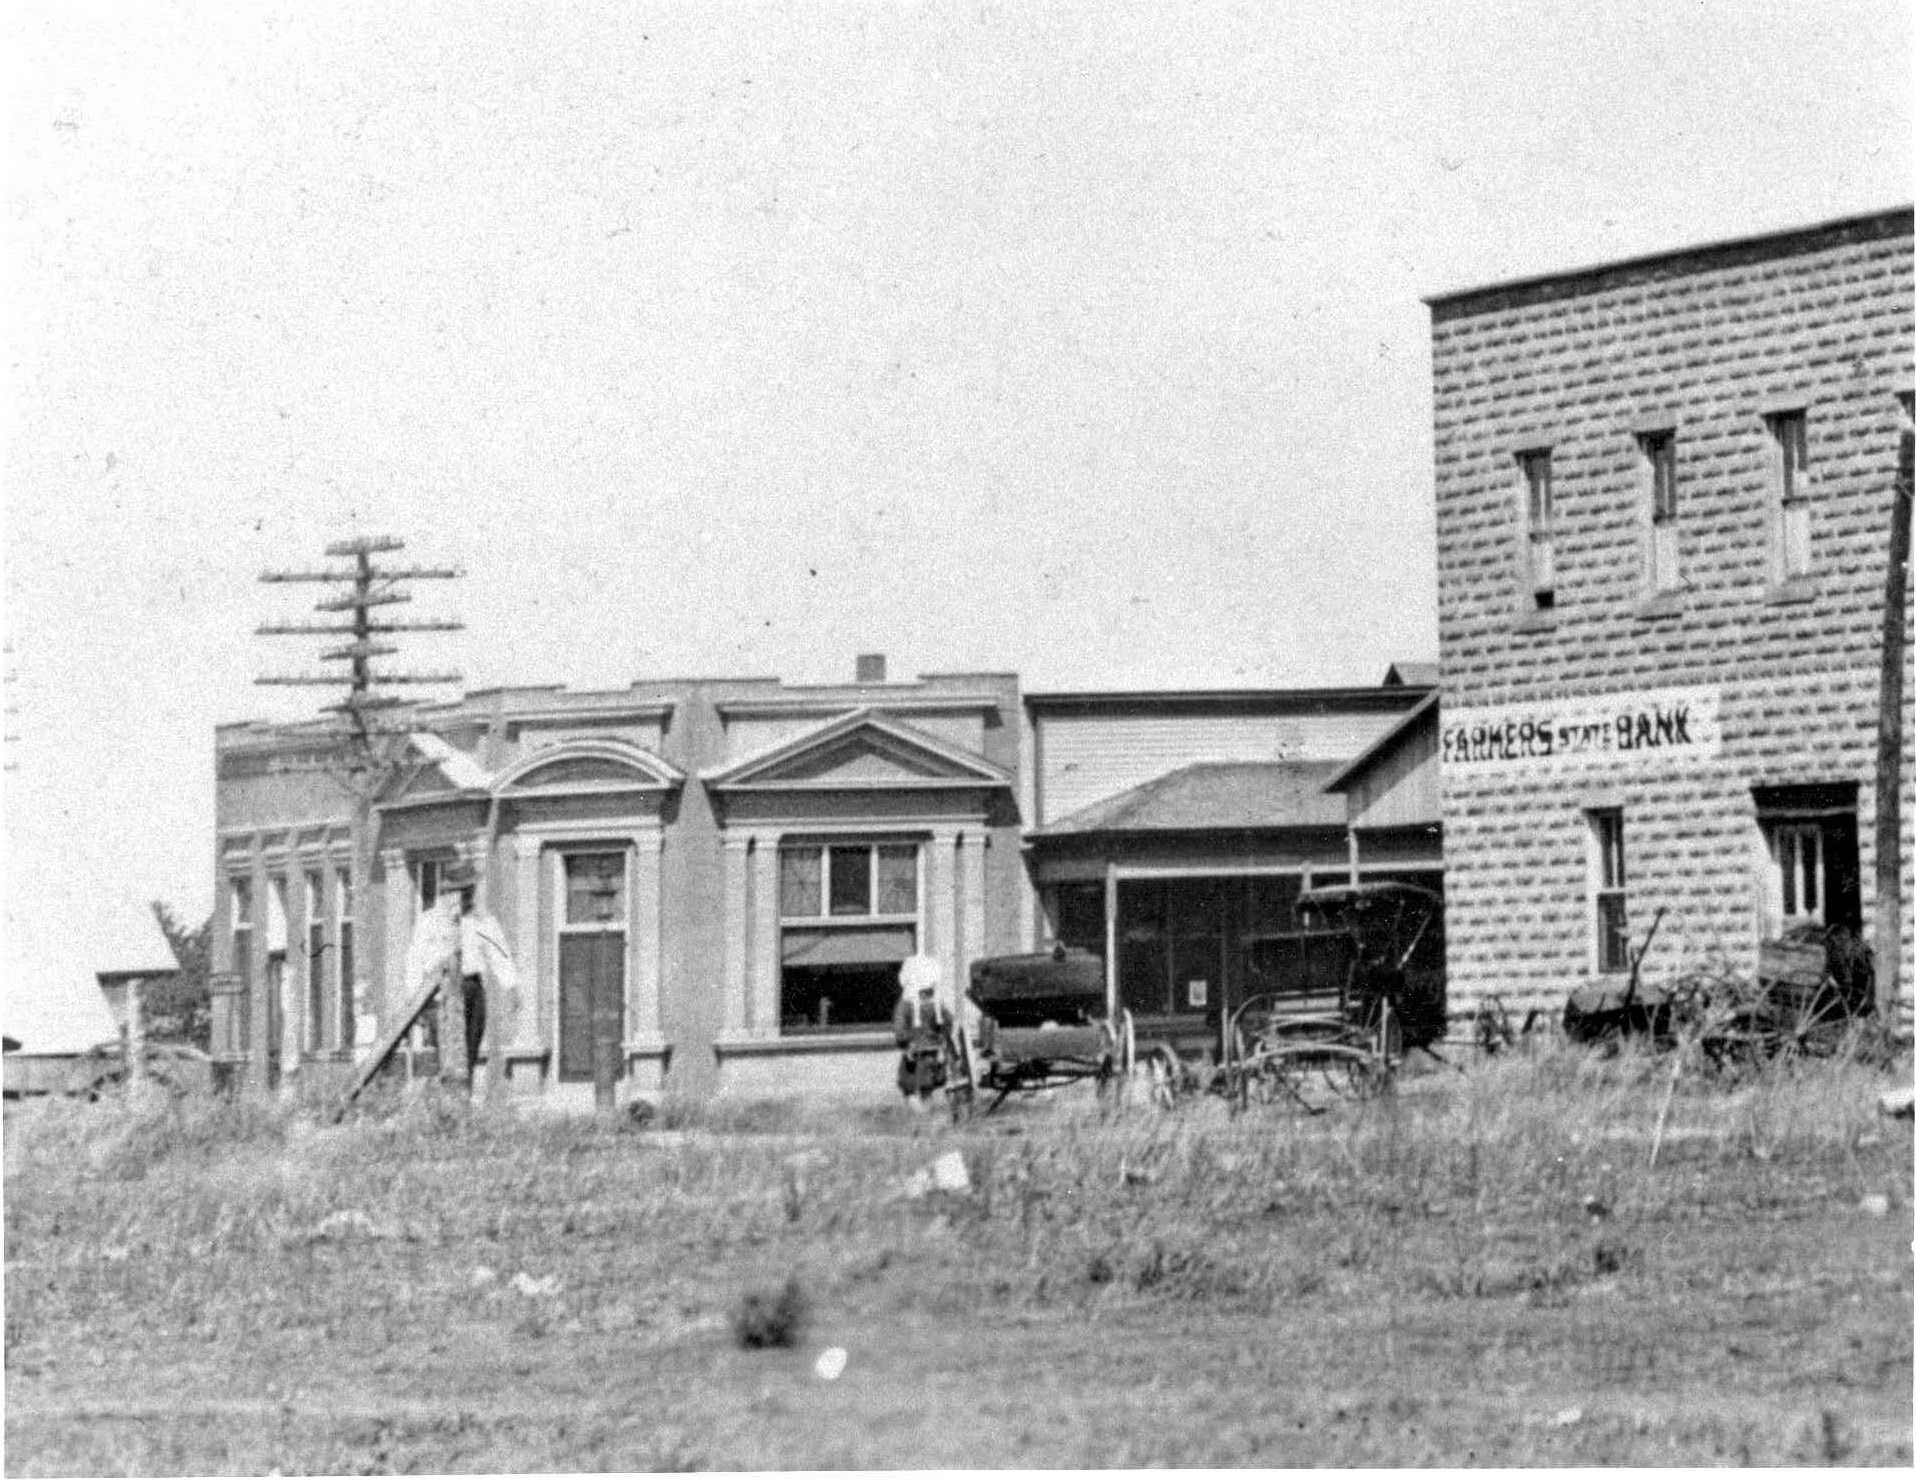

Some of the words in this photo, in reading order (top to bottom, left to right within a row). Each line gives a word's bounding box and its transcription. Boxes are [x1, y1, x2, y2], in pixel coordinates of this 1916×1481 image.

[1442, 720, 1552, 763] FARMERS
[1558, 722, 1611, 748] STATE
[1616, 706, 1692, 750] BANK
